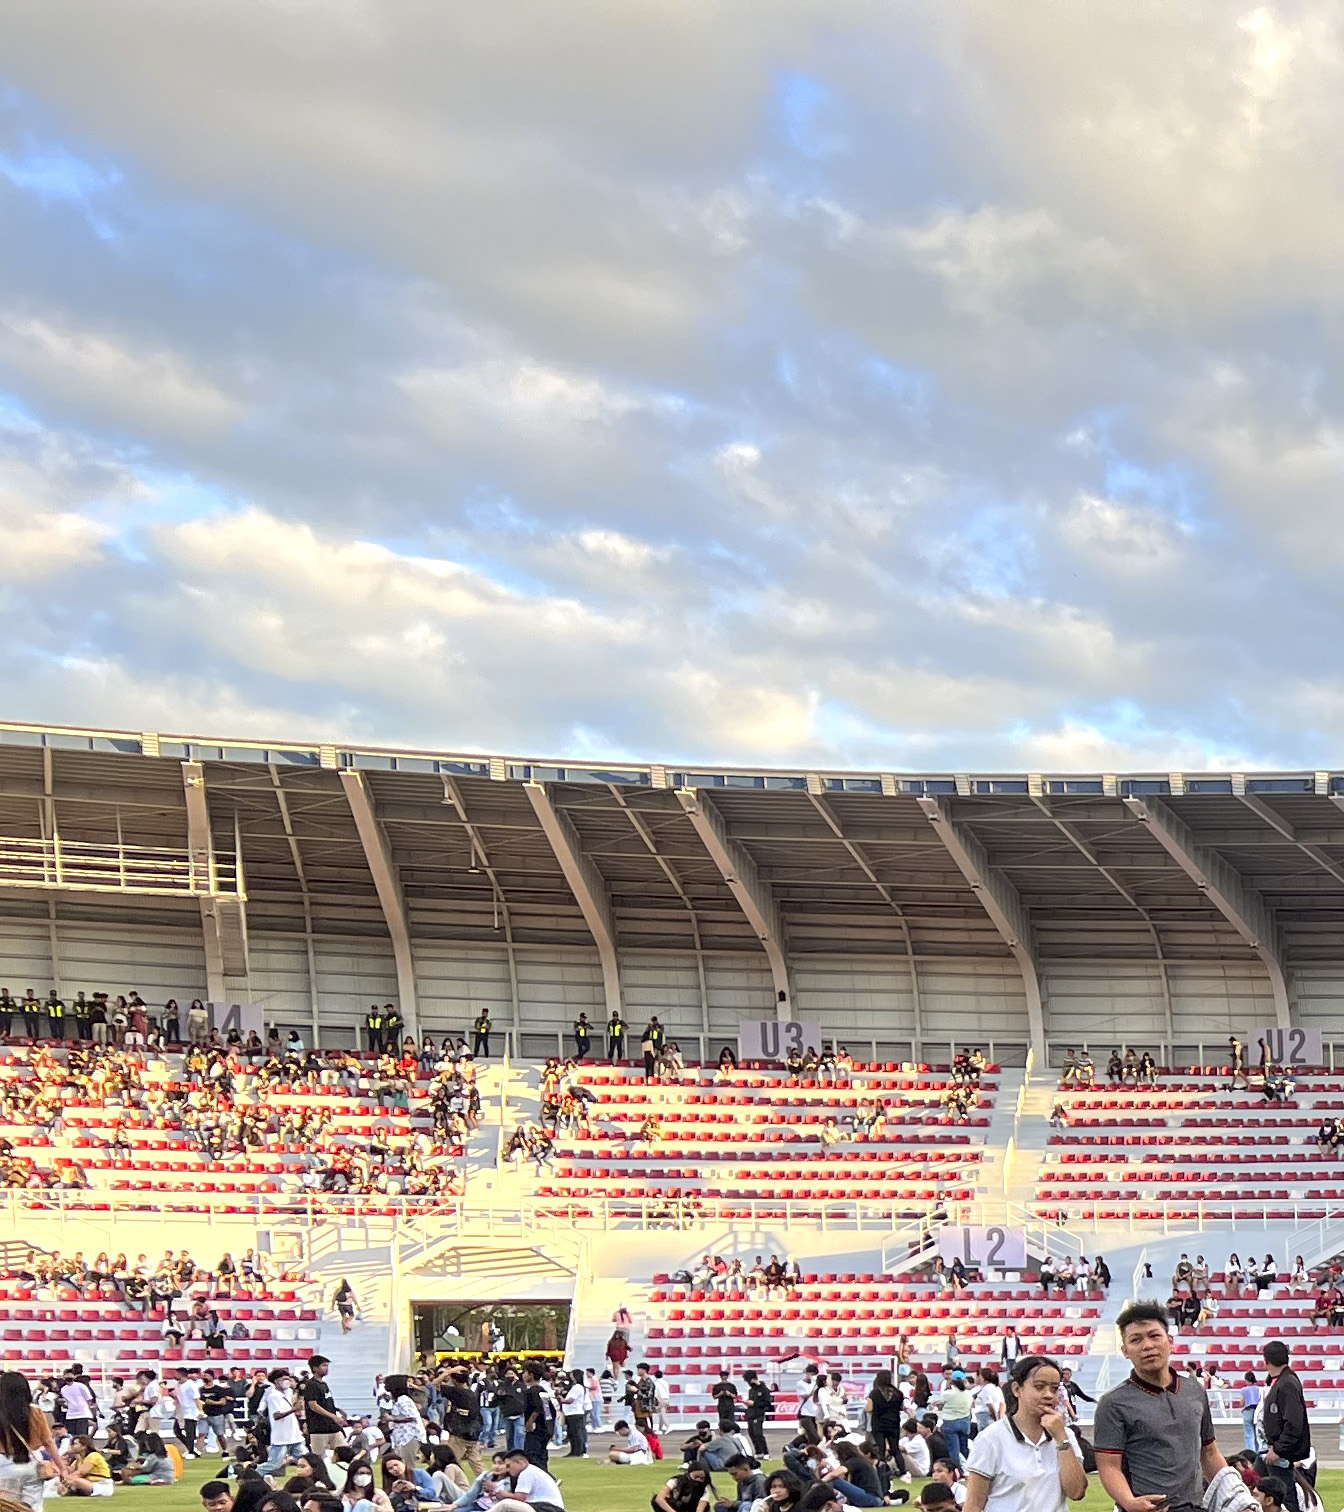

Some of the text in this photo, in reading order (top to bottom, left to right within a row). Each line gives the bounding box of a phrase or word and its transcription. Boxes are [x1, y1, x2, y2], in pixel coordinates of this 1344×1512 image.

[761, 1022, 803, 1058] U3
[1266, 1029, 1306, 1064] U2
[963, 1227, 1005, 1266] L2
